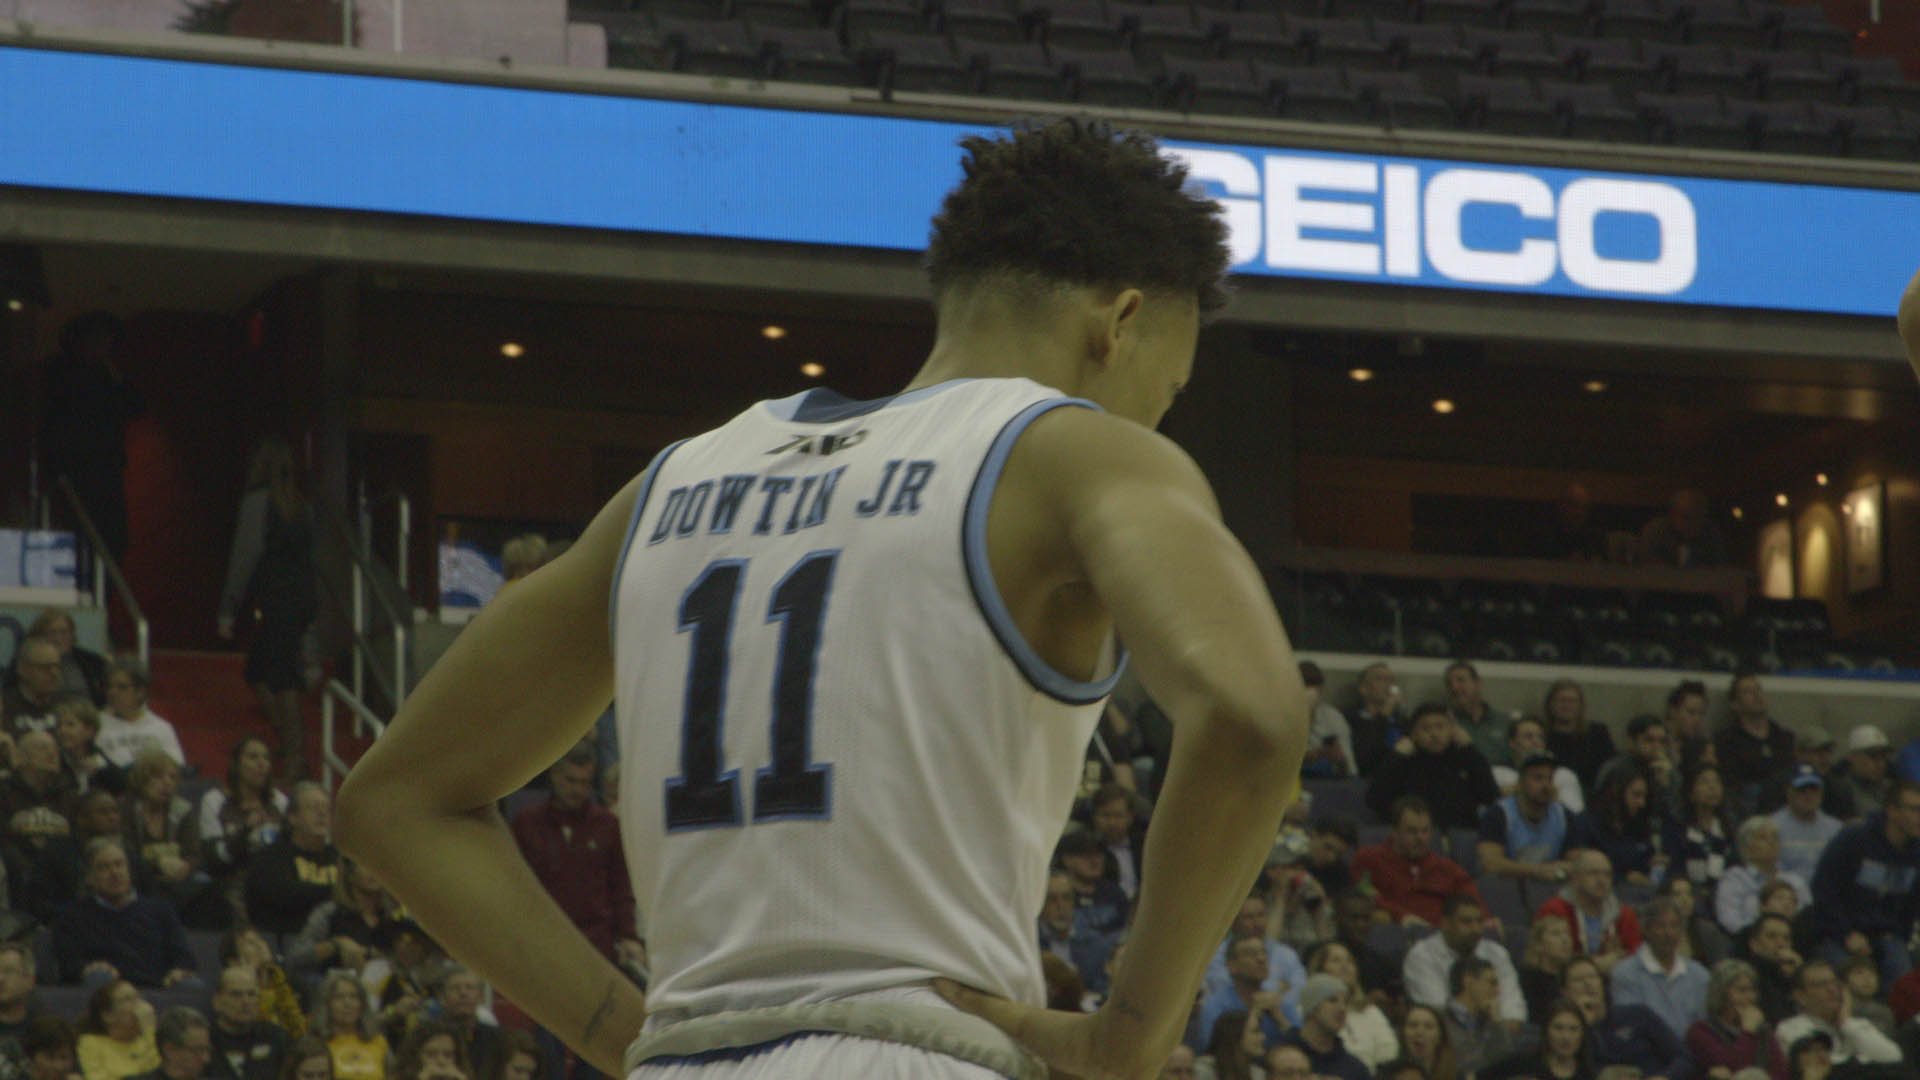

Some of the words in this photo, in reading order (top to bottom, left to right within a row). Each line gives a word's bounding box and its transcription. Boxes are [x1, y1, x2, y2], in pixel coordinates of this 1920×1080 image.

[649, 465, 848, 545] DOWTIN
[857, 459, 937, 518] JR
[664, 549, 843, 834] 11
